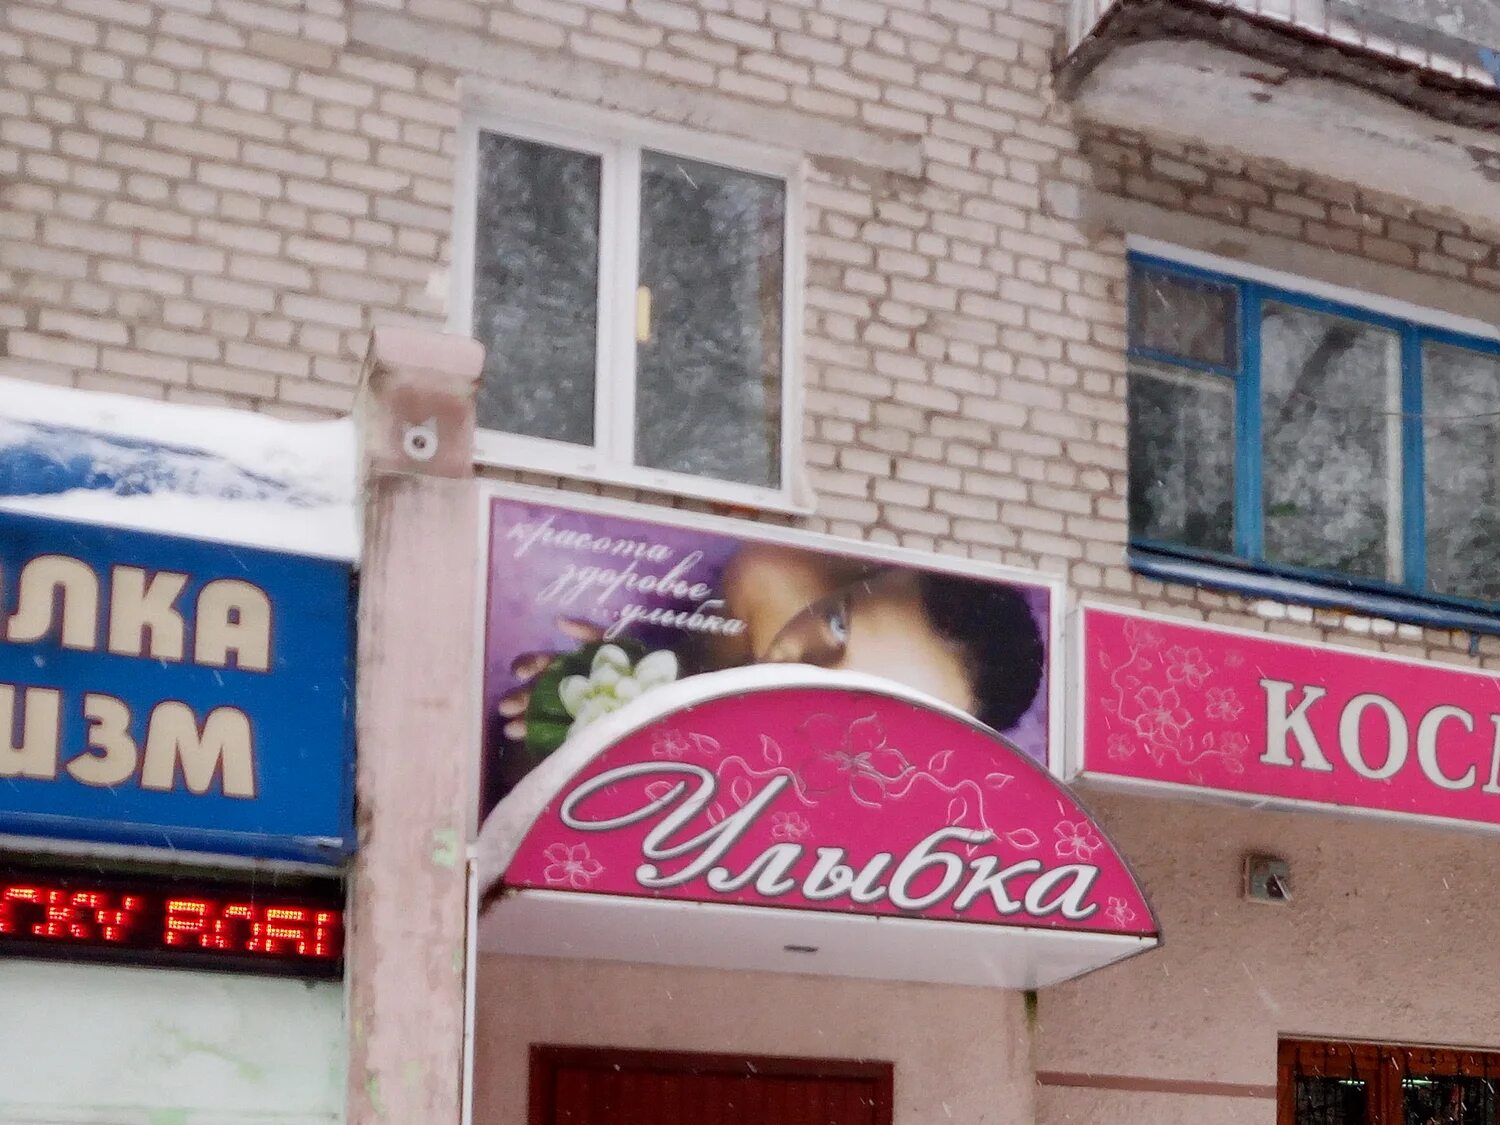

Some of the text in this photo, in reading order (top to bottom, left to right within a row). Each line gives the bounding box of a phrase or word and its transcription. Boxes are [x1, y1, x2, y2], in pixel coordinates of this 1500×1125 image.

[505, 515, 675, 562] красота
[537, 550, 712, 604] здоровье
[6, 554, 271, 672] ЛКА
[603, 599, 748, 642] улыбка
[560, 762, 1100, 920] Улыбка
